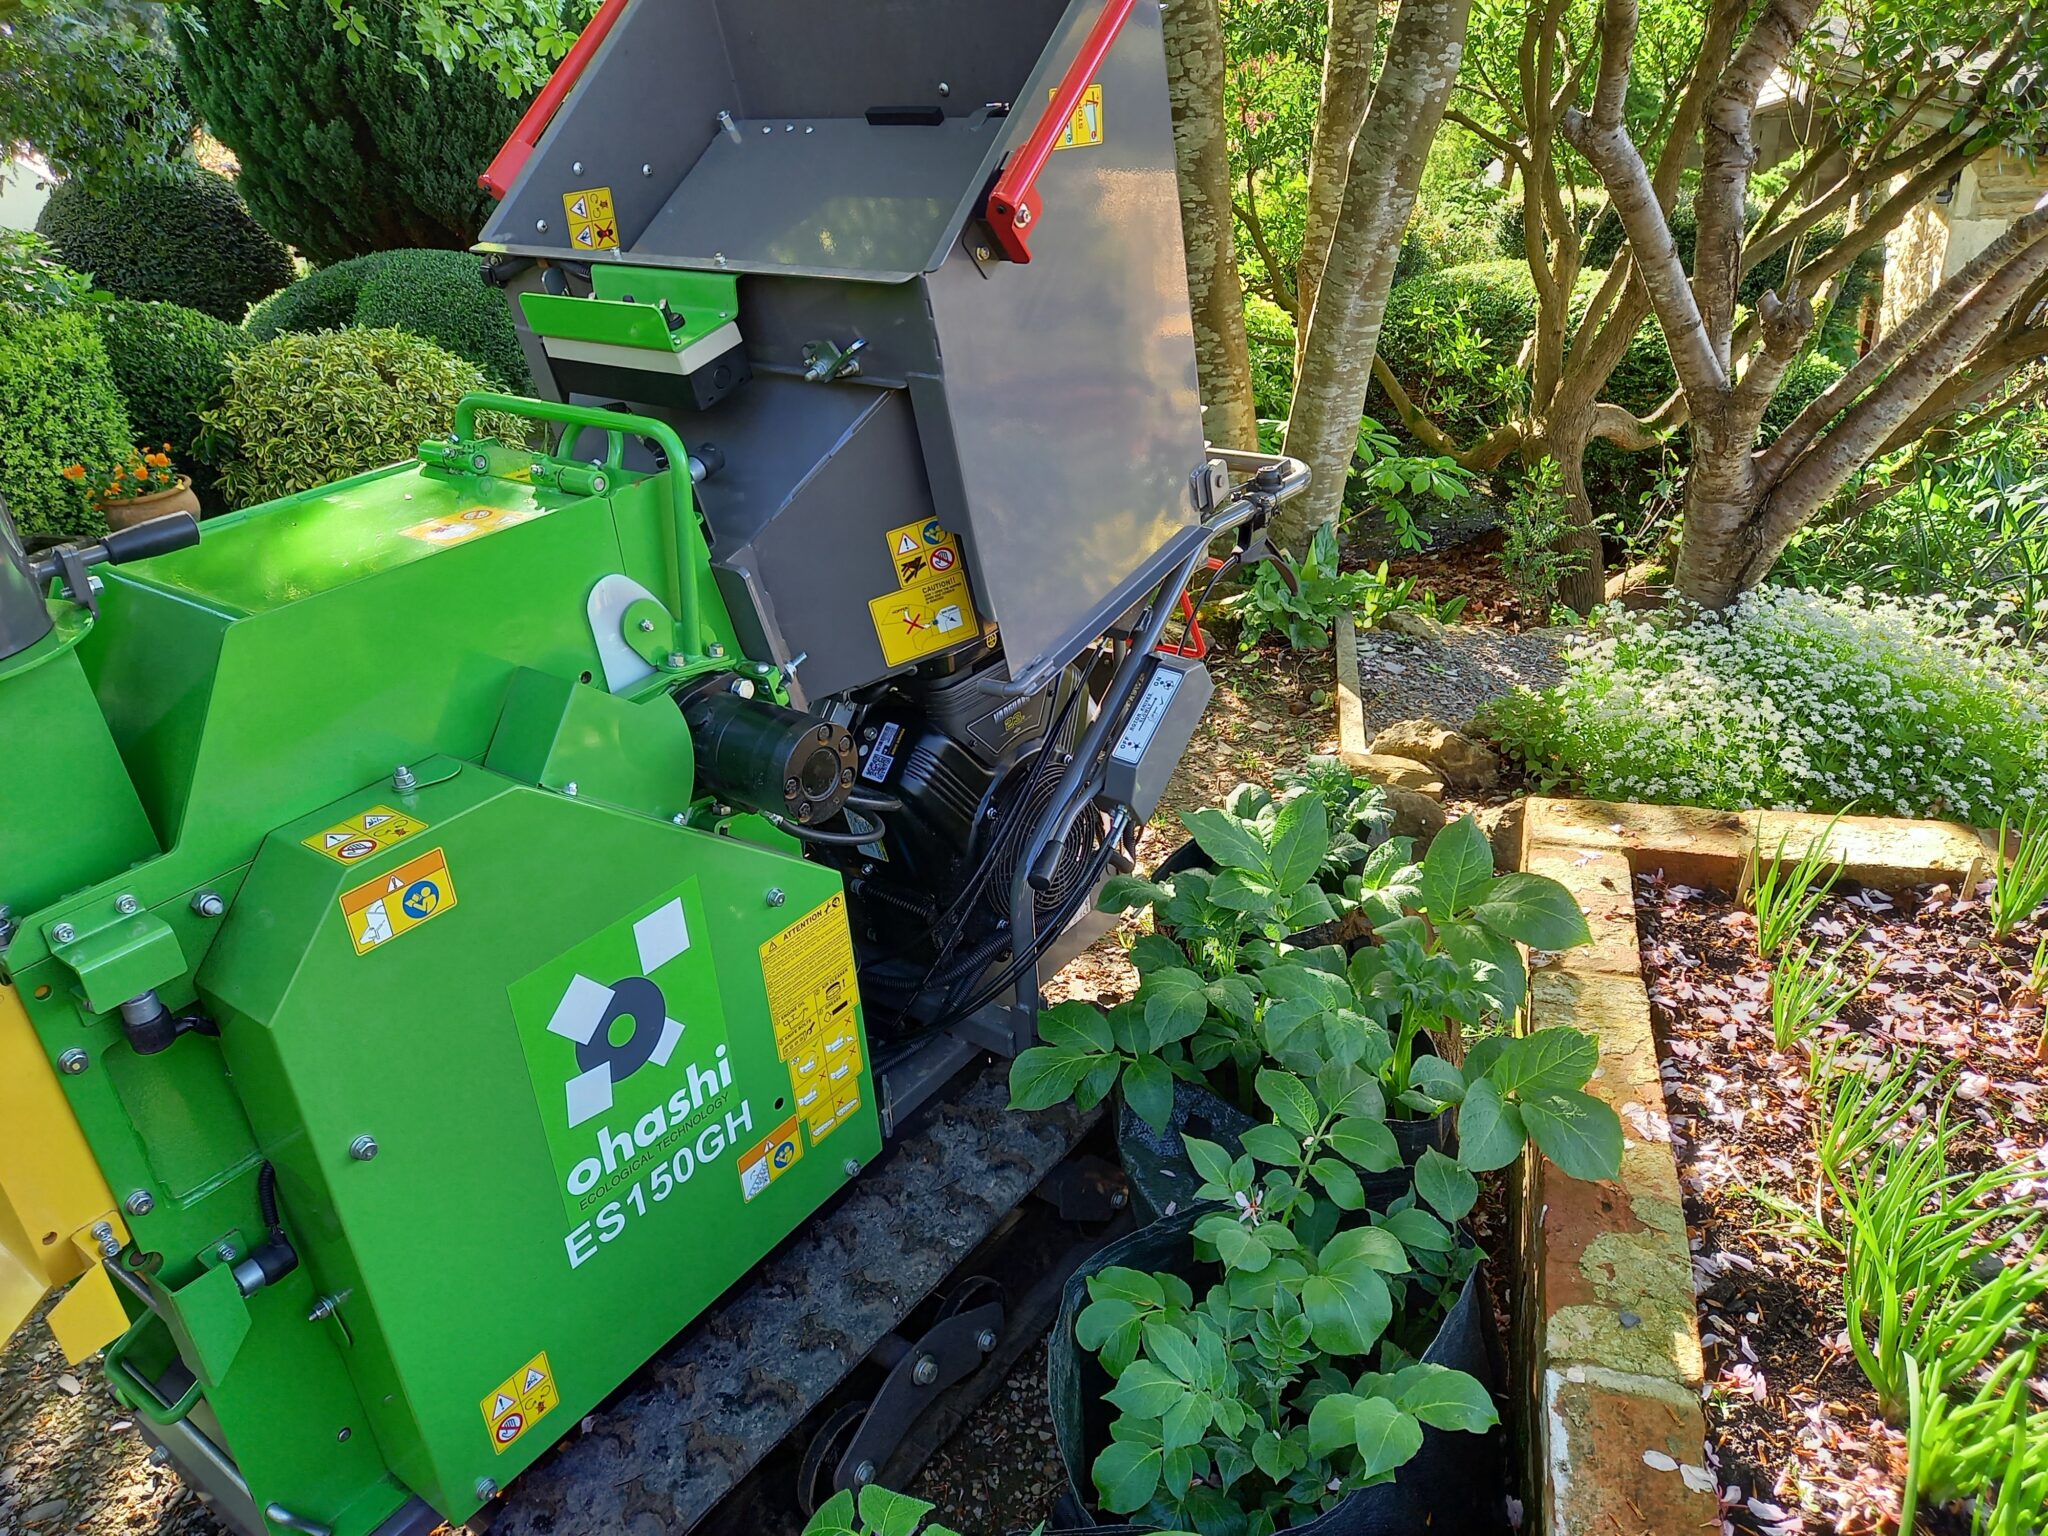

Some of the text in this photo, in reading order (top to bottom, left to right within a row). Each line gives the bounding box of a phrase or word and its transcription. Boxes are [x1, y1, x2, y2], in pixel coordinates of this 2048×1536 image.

[1153, 676, 1162, 687] ON
[1120, 737, 1129, 749] OFF
[783, 910, 823, 941] ATTENTION
[567, 1044, 732, 1196] ohashi
[579, 1091, 729, 1211] ECOLOGICAL TECHNOLOGY
[564, 1099, 753, 1270] ES150GH
